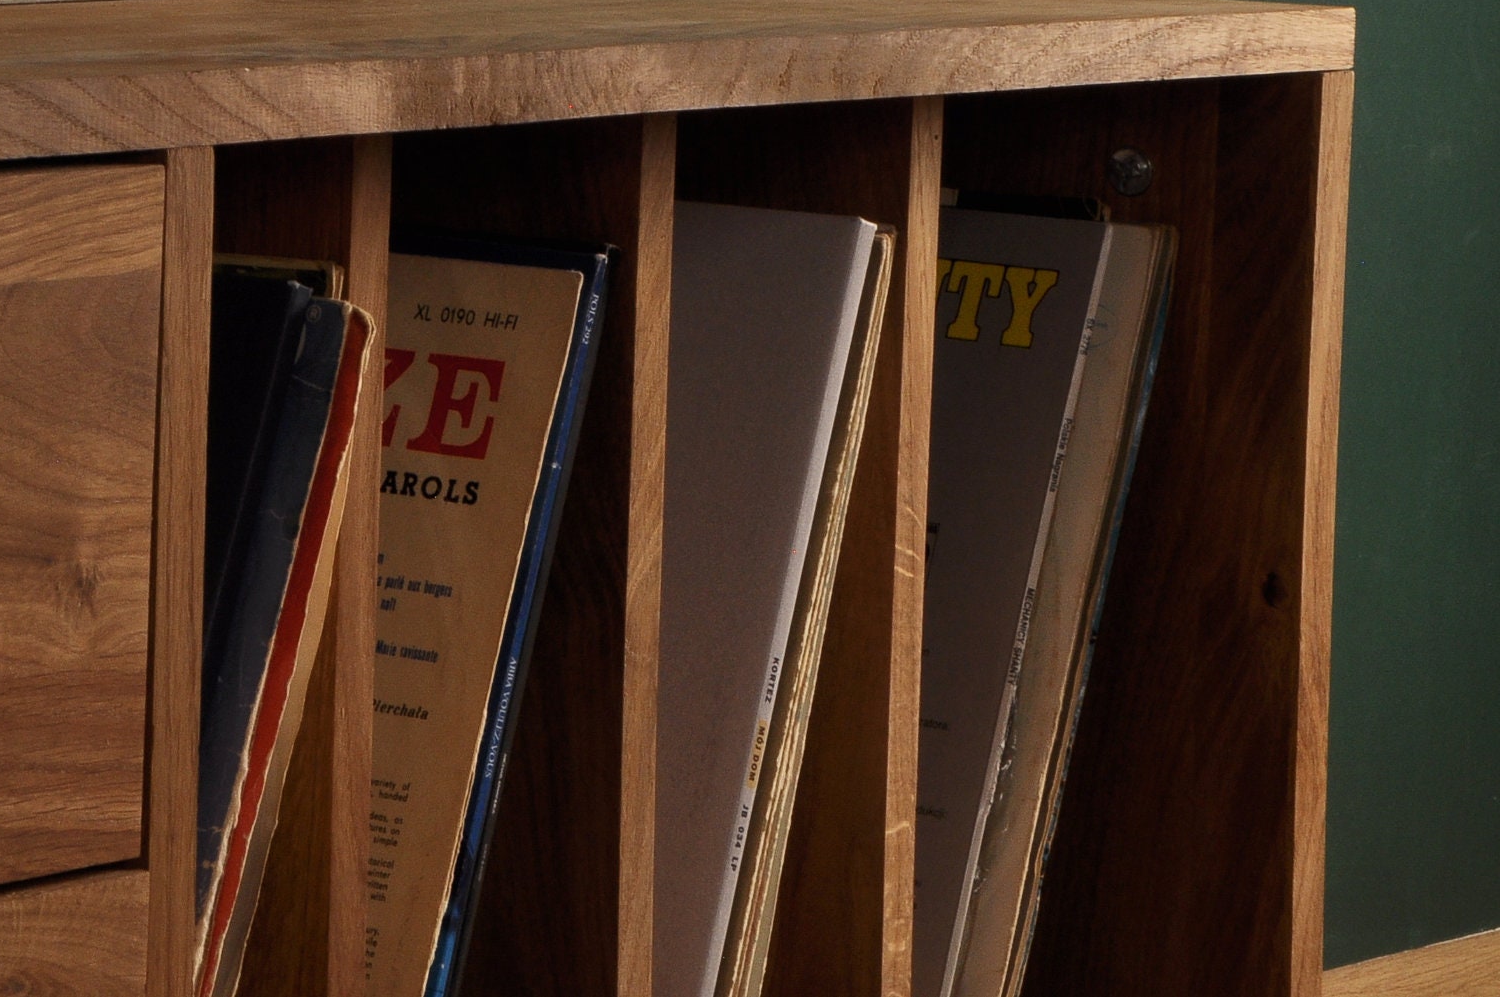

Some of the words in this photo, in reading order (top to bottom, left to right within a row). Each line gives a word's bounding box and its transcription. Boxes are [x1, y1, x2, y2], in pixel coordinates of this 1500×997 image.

[414, 303, 431, 321] XL
[440, 306, 476, 326] 0190
[483, 311, 519, 331] HI-FI
[380, 470, 480, 505] AROLS
[765, 657, 780, 704] KORTEZ
[755, 725, 765, 751] MÓJ
[748, 754, 759, 782] DOM
[740, 804, 749, 819] JB
[734, 826, 745, 849] 034
[730, 856, 739, 873] LP
